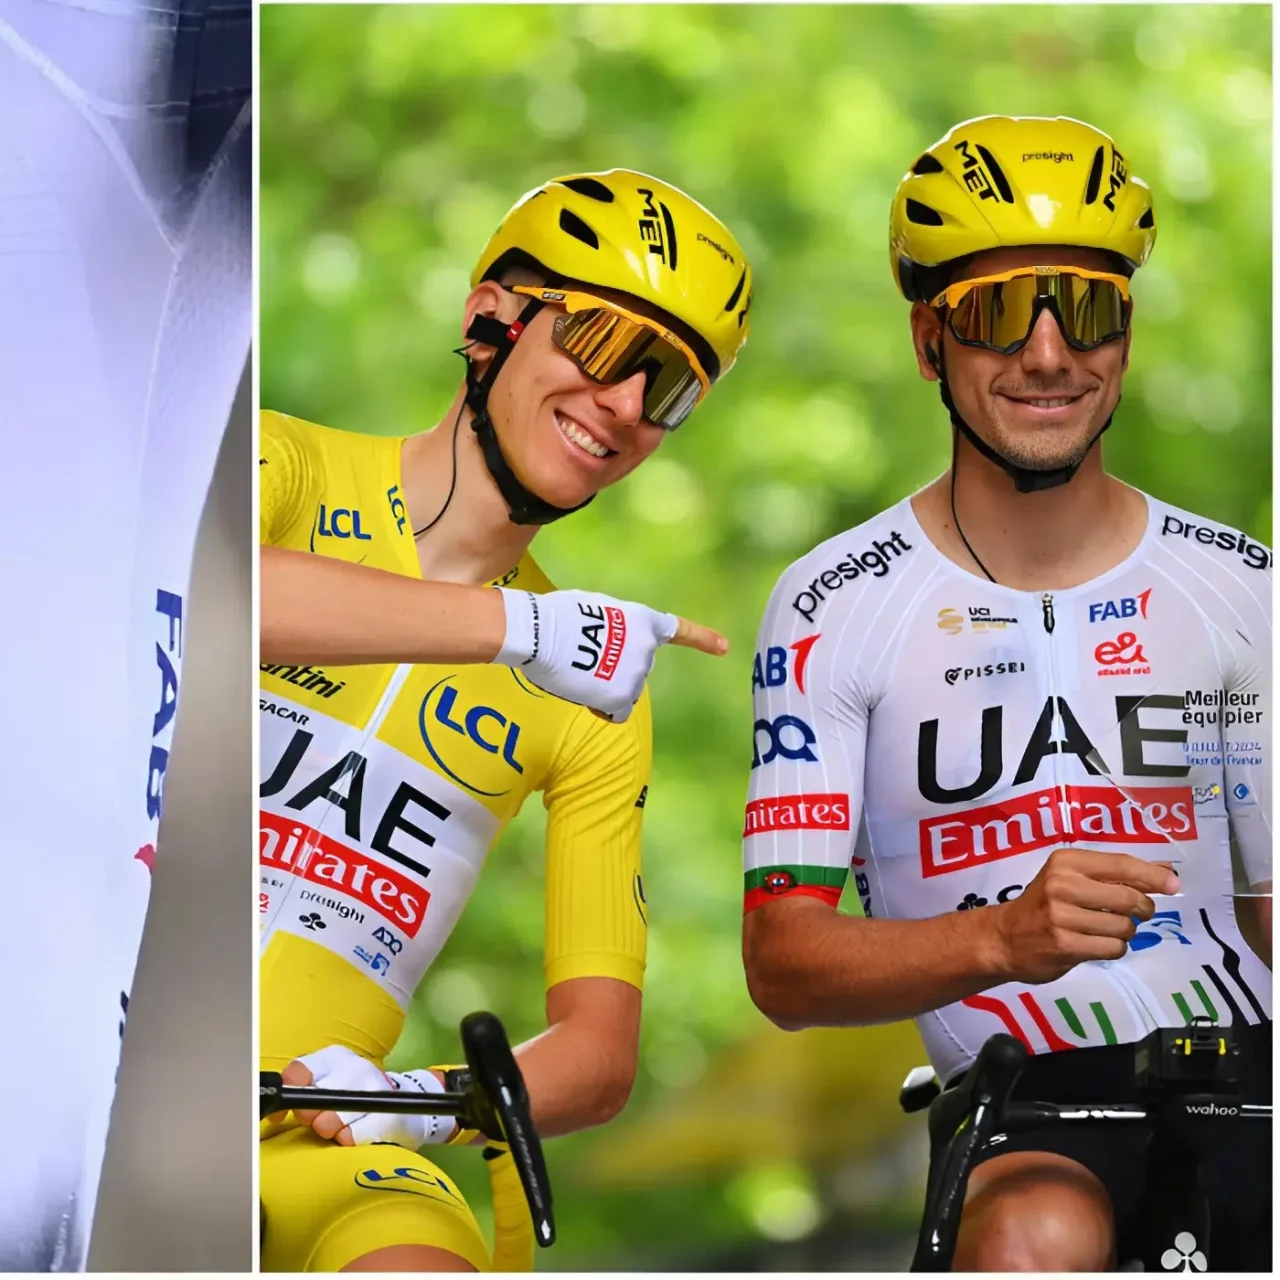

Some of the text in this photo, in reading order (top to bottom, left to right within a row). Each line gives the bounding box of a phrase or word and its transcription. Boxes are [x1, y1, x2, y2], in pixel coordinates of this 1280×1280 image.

[954, 140, 1000, 203] MET
[636, 188, 666, 265] MET
[318, 504, 372, 540] LCL
[387, 484, 406, 535] LCL
[792, 530, 912, 623] presight
[571, 602, 606, 672] UAE
[1182, 707, 1263, 728] équpier
[1185, 689, 1260, 706] Meilleur
[435, 685, 524, 775] LCL
[752, 715, 819, 770] DQ
[918, 694, 1191, 804] UAE
[927, 794, 1191, 867] Emirates
[1185, 1104, 1238, 1117] wahoo
